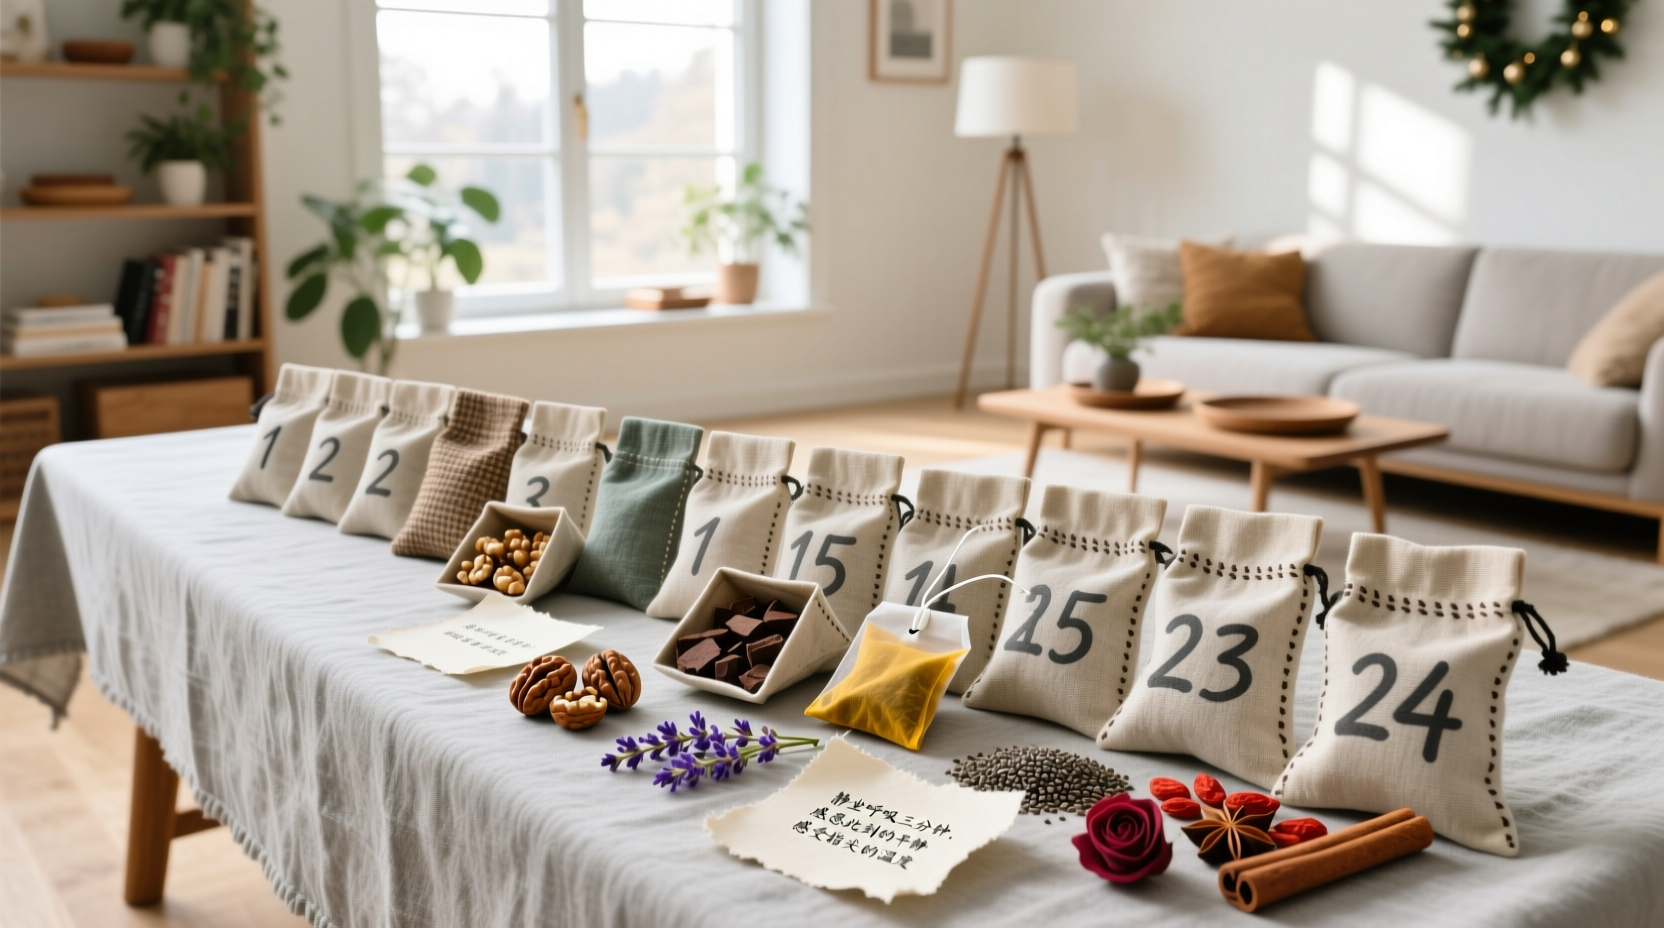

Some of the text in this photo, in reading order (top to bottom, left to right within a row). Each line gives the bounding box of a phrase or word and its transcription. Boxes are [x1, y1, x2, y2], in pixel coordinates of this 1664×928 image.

[259, 425, 283, 470] 1
[307, 436, 342, 484] 2
[364, 448, 401, 498] 2
[692, 516, 721, 577] 1
[788, 529, 858, 597] 15
[1002, 583, 1109, 666] 25
[1146, 612, 1260, 703] 23
[1333, 652, 1464, 764] 24
